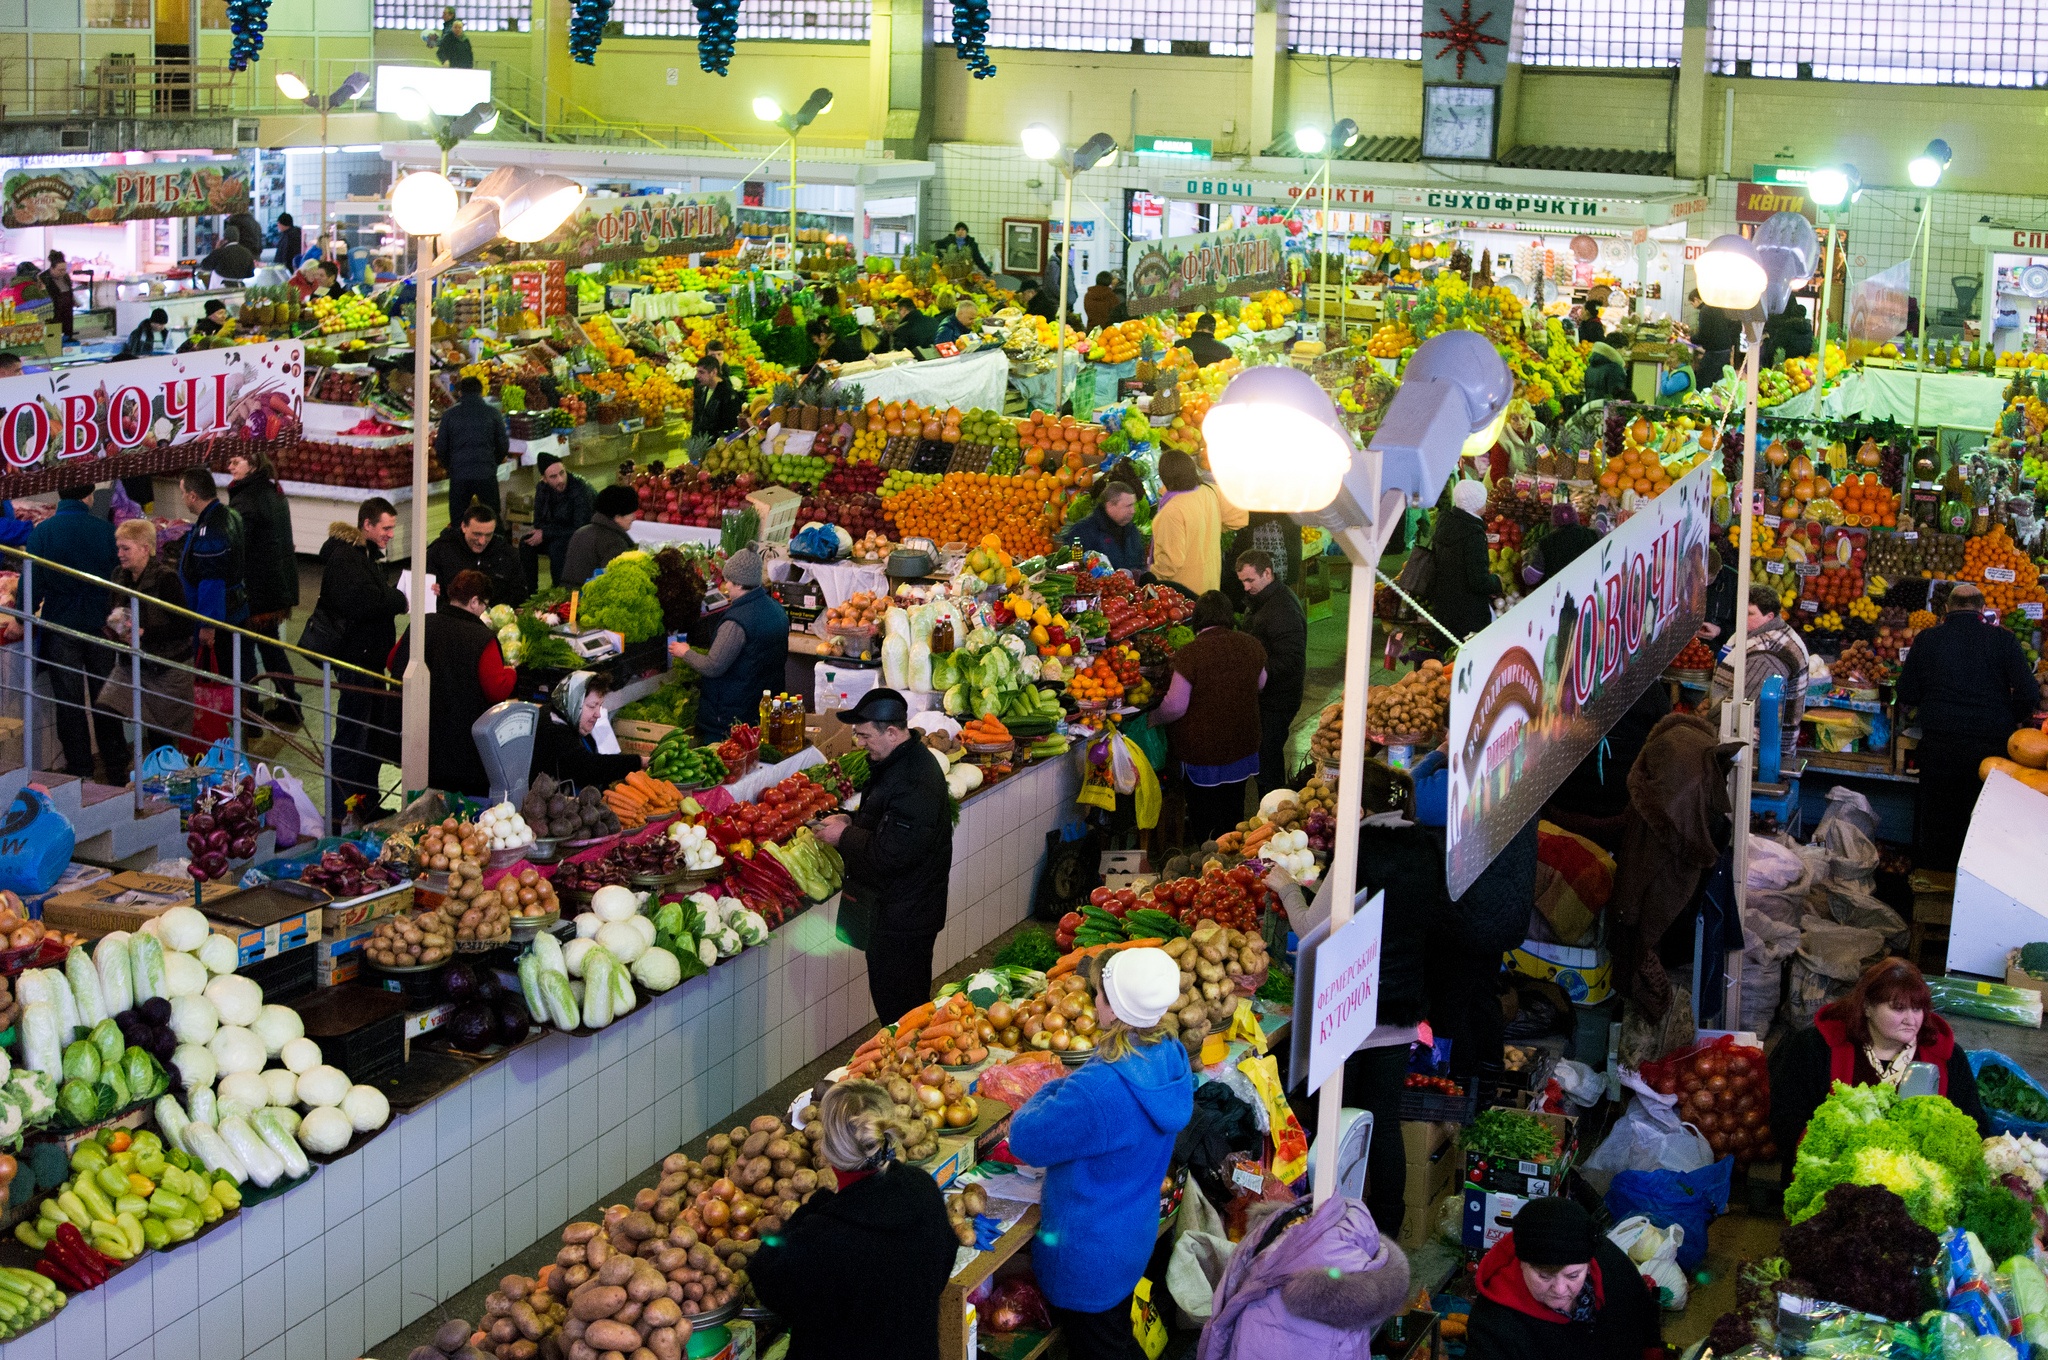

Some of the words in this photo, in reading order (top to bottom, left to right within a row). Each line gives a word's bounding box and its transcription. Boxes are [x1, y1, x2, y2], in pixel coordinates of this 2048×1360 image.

[115, 173, 204, 206] РИБА
[1187, 180, 1252, 197] ОВОЧІ
[1428, 193, 1597, 216] СУХОФРУКТИ
[1748, 194, 1804, 212] КВІТИ
[597, 204, 715, 244] ФРУКТИ
[1181, 239, 1269, 285] ФРУКТИ
[1685, 245, 1708, 260] СП
[2, 373, 230, 466] ОВОЧІ
[1574, 519, 1682, 705] ОВОЧІ
[1468, 664, 1538, 759] ВОЛОДИМИРСЬКИЙ
[1486, 717, 1521, 775] РИНОК
[1317, 936, 1378, 1010] ФЕРМЕРСЬКИЙ
[1320, 973, 1373, 1046] КУТОЧОК
